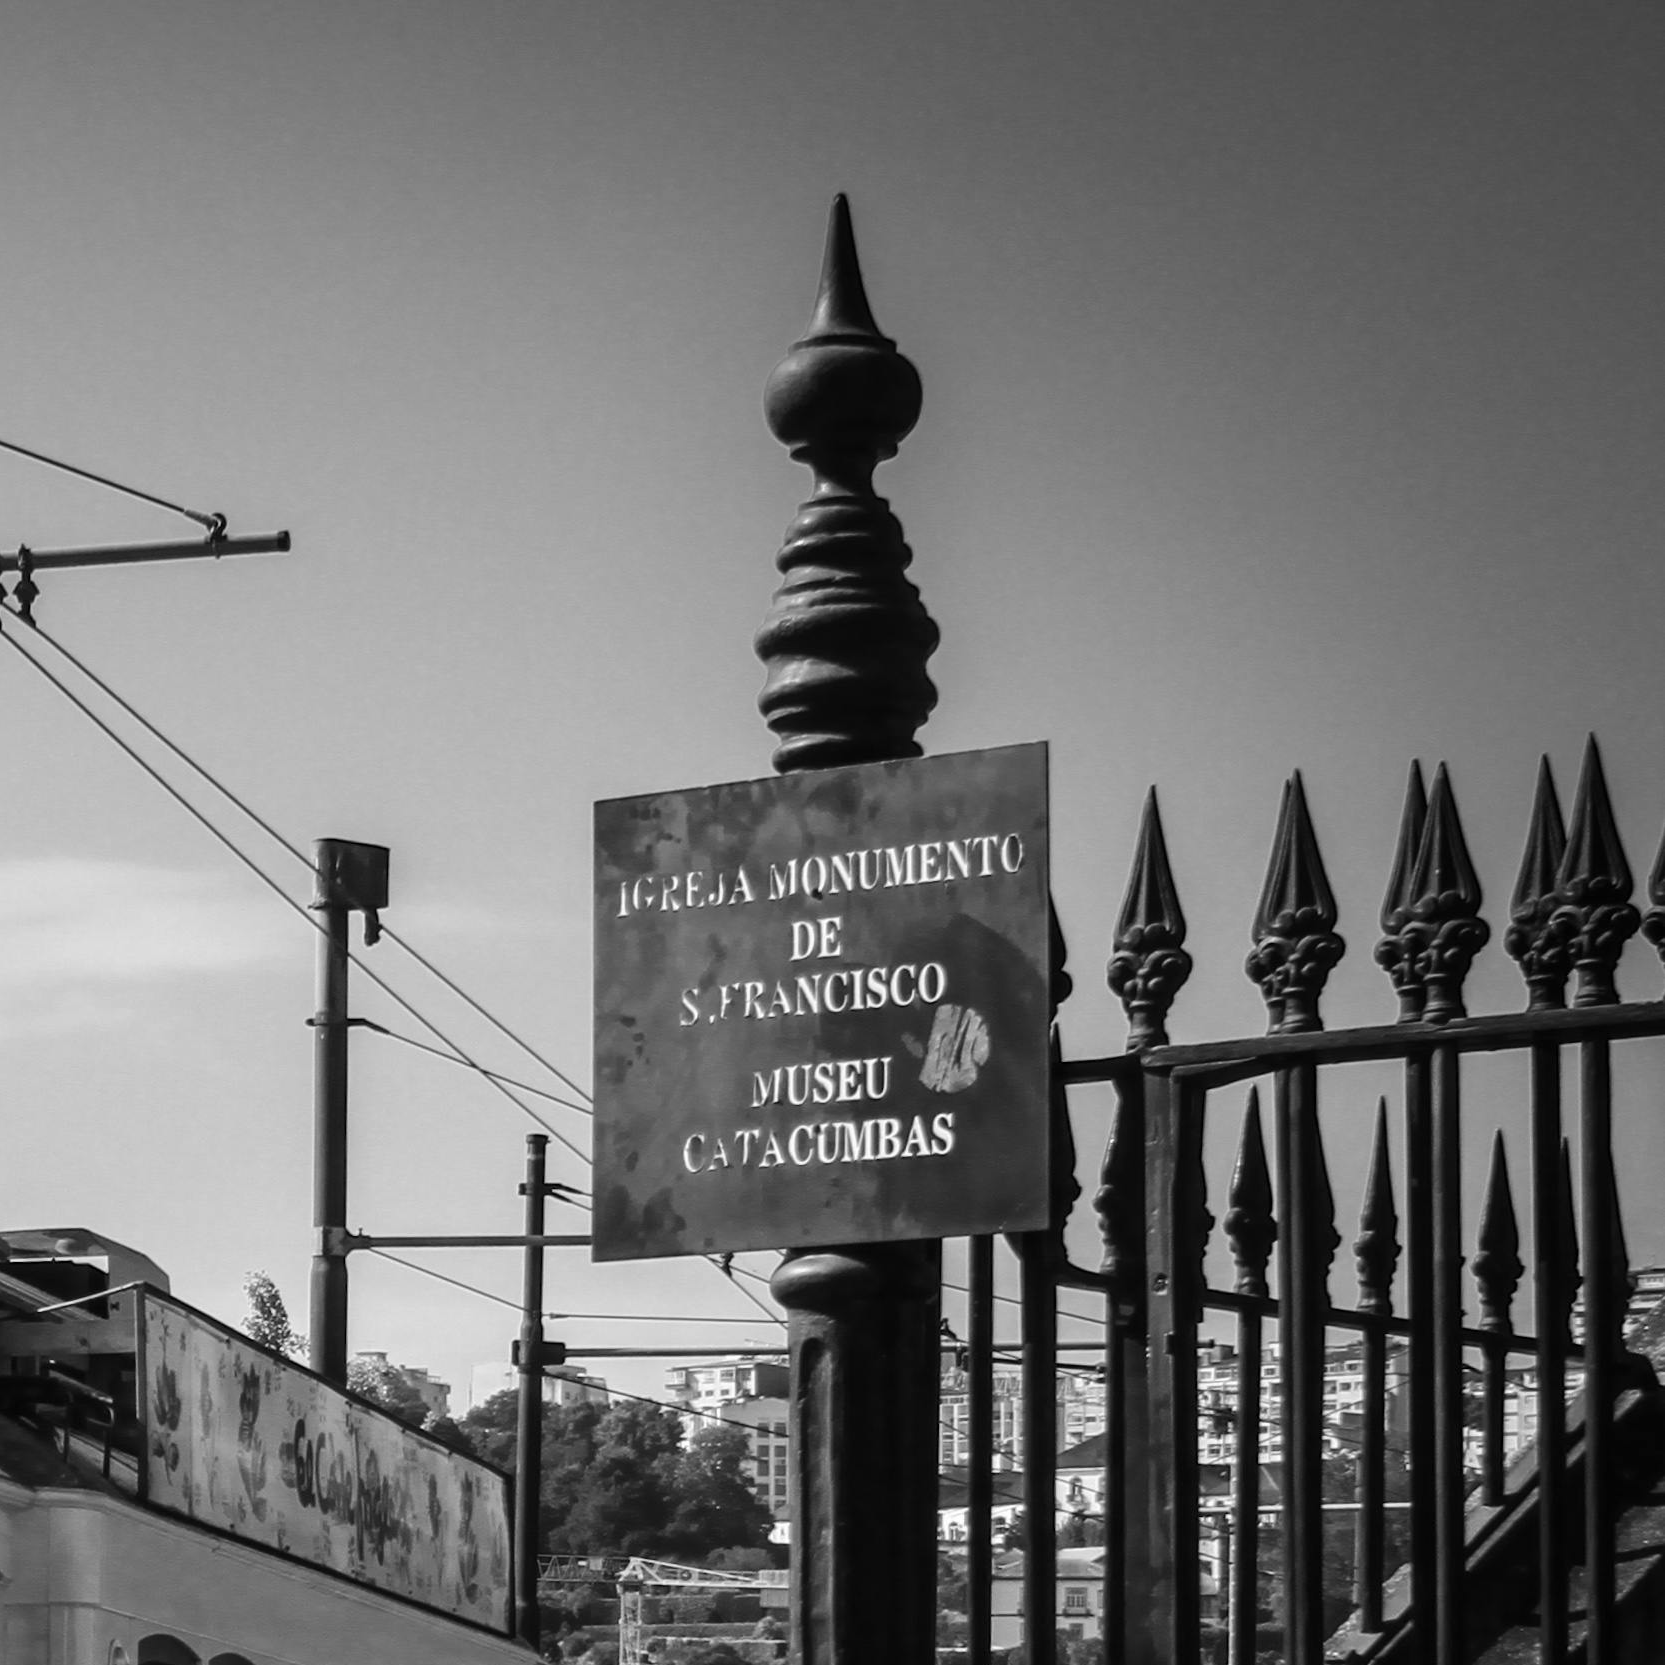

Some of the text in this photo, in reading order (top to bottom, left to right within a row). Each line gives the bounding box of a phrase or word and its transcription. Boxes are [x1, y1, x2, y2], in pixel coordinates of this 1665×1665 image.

[616, 833, 1025, 918] IGREJA MONUMENTO
[790, 917, 842, 961] DE
[750, 1057, 893, 1108] MUSEU
[682, 1112, 956, 1173] CATACUMBAS
